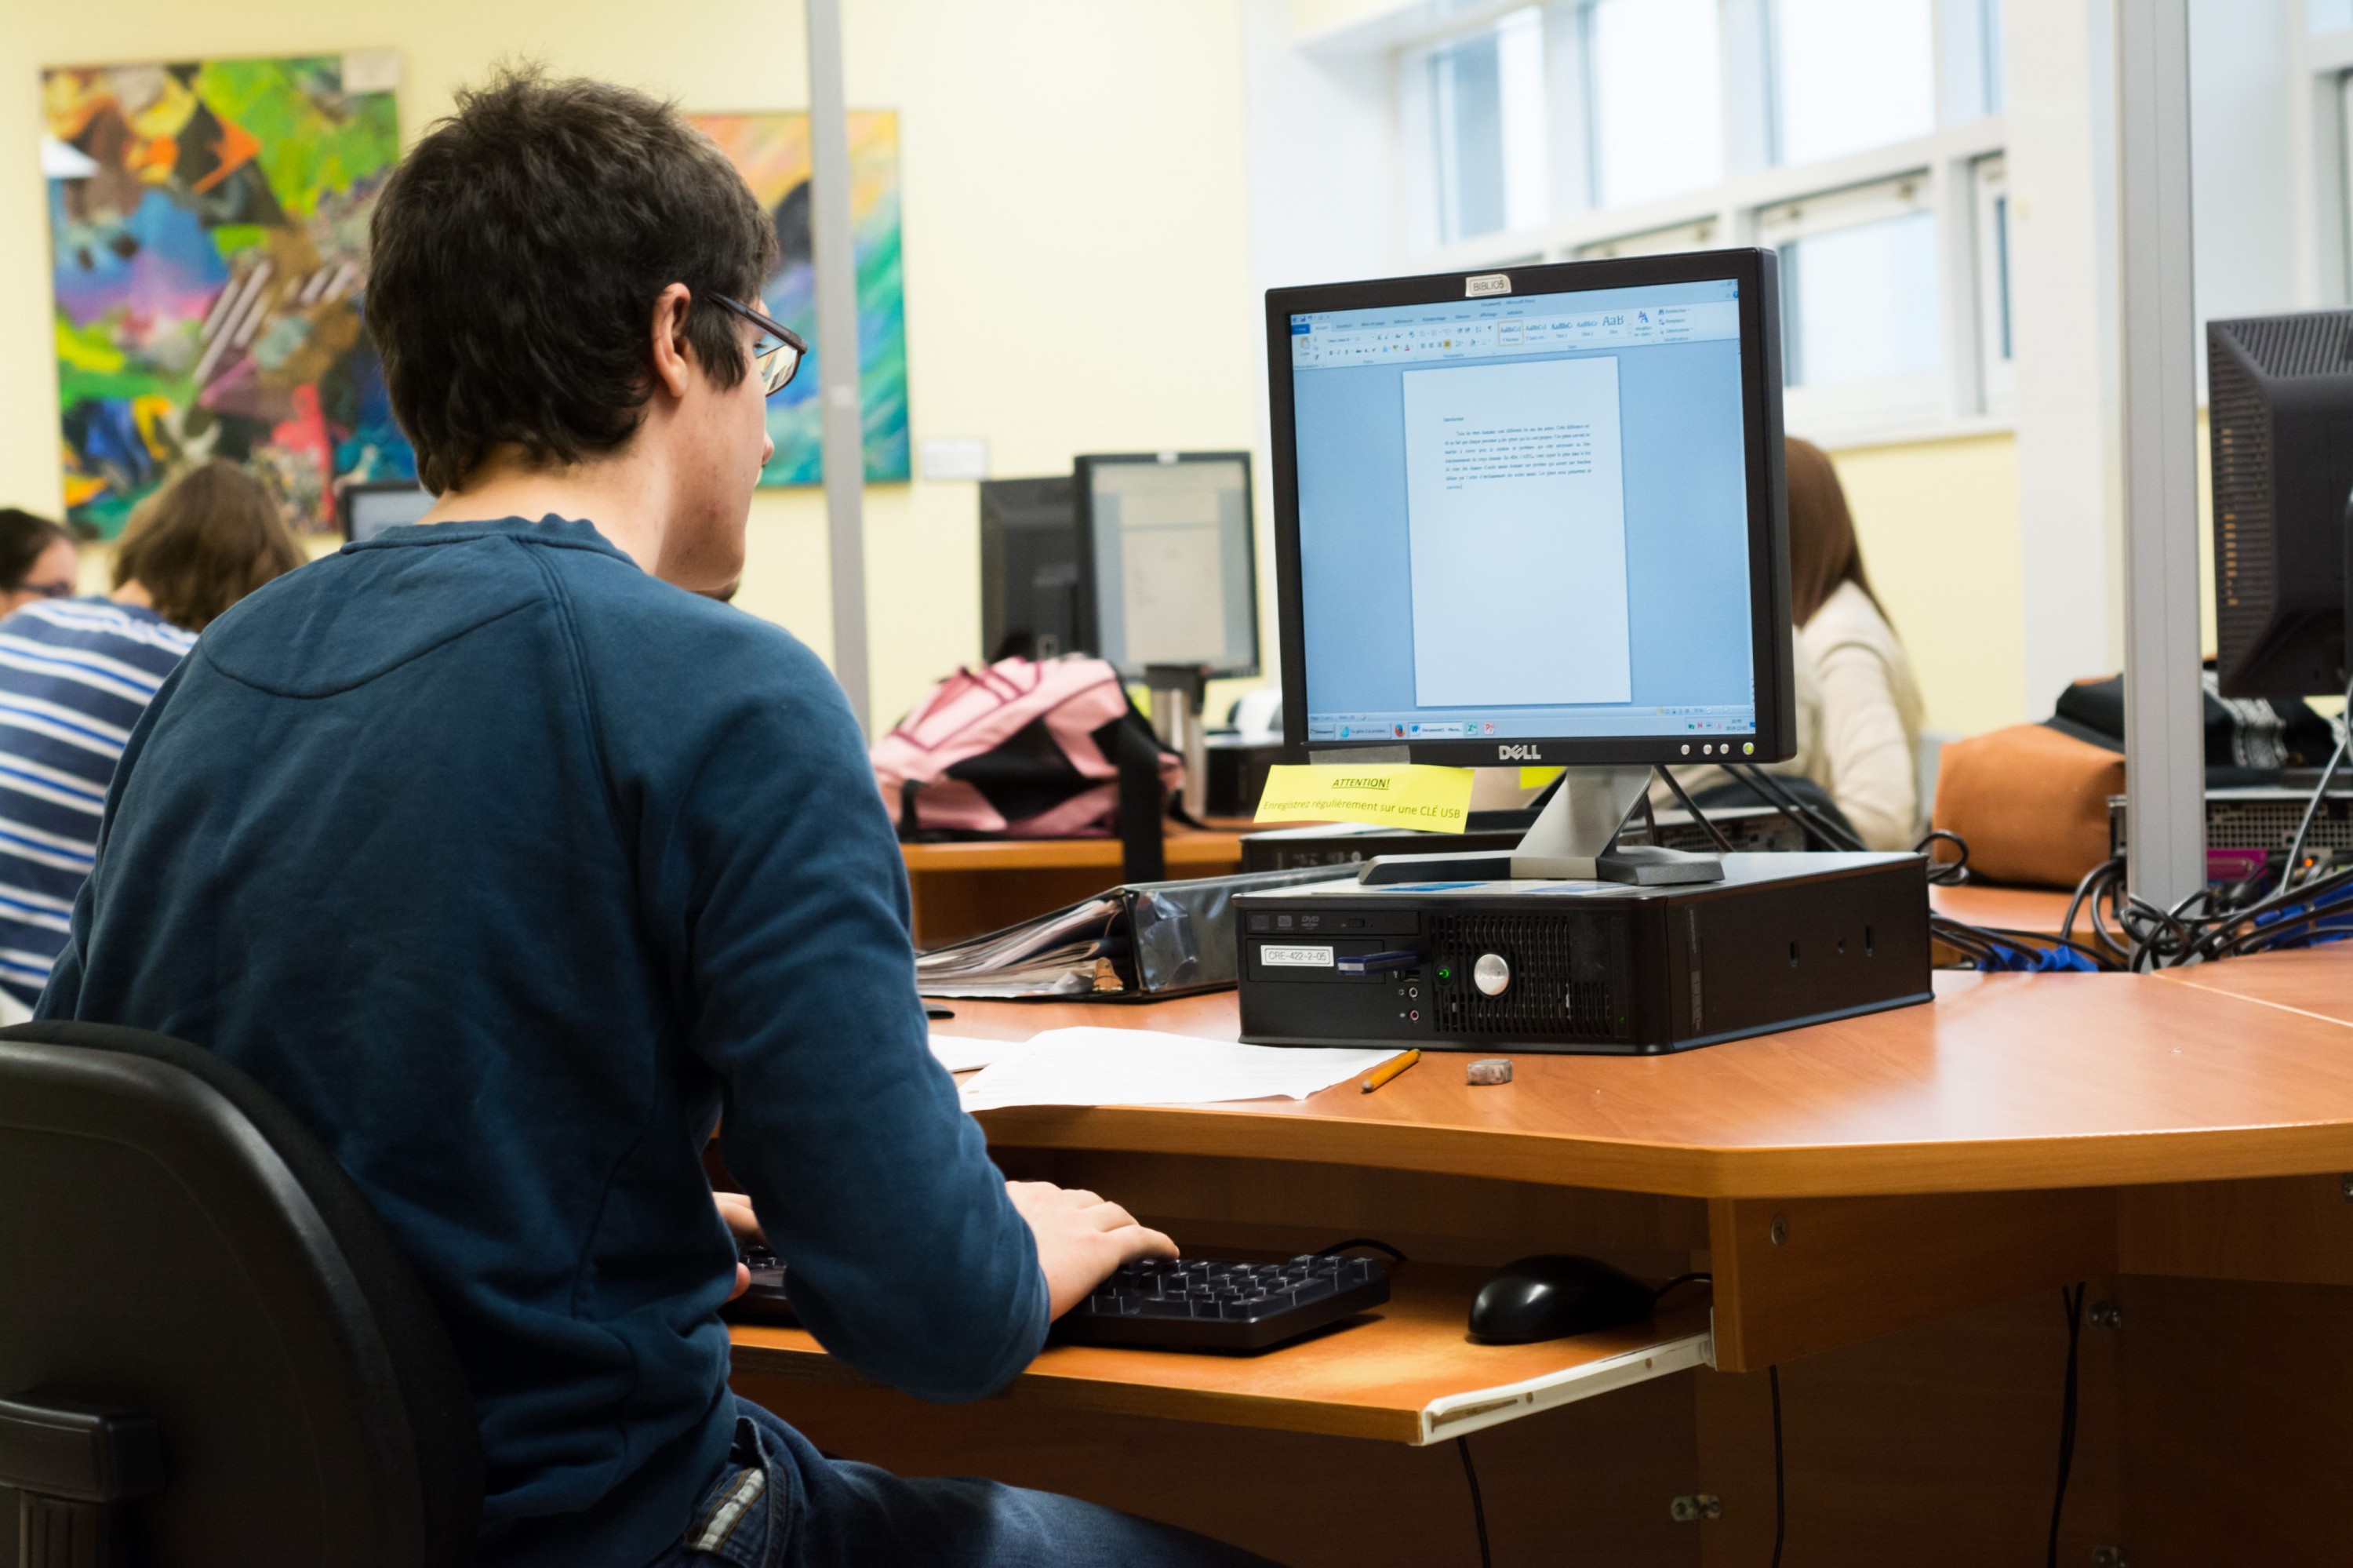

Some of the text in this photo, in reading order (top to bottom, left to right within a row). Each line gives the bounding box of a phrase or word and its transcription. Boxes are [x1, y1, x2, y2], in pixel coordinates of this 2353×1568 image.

[1498, 744, 1542, 761] DELL
[1331, 778, 1391, 790] ATTENTION!
[1264, 799, 1460, 819] Enregistrez régulièrement sur une CLÉ USB
[1268, 950, 1326, 962] CRE-422-2-05
